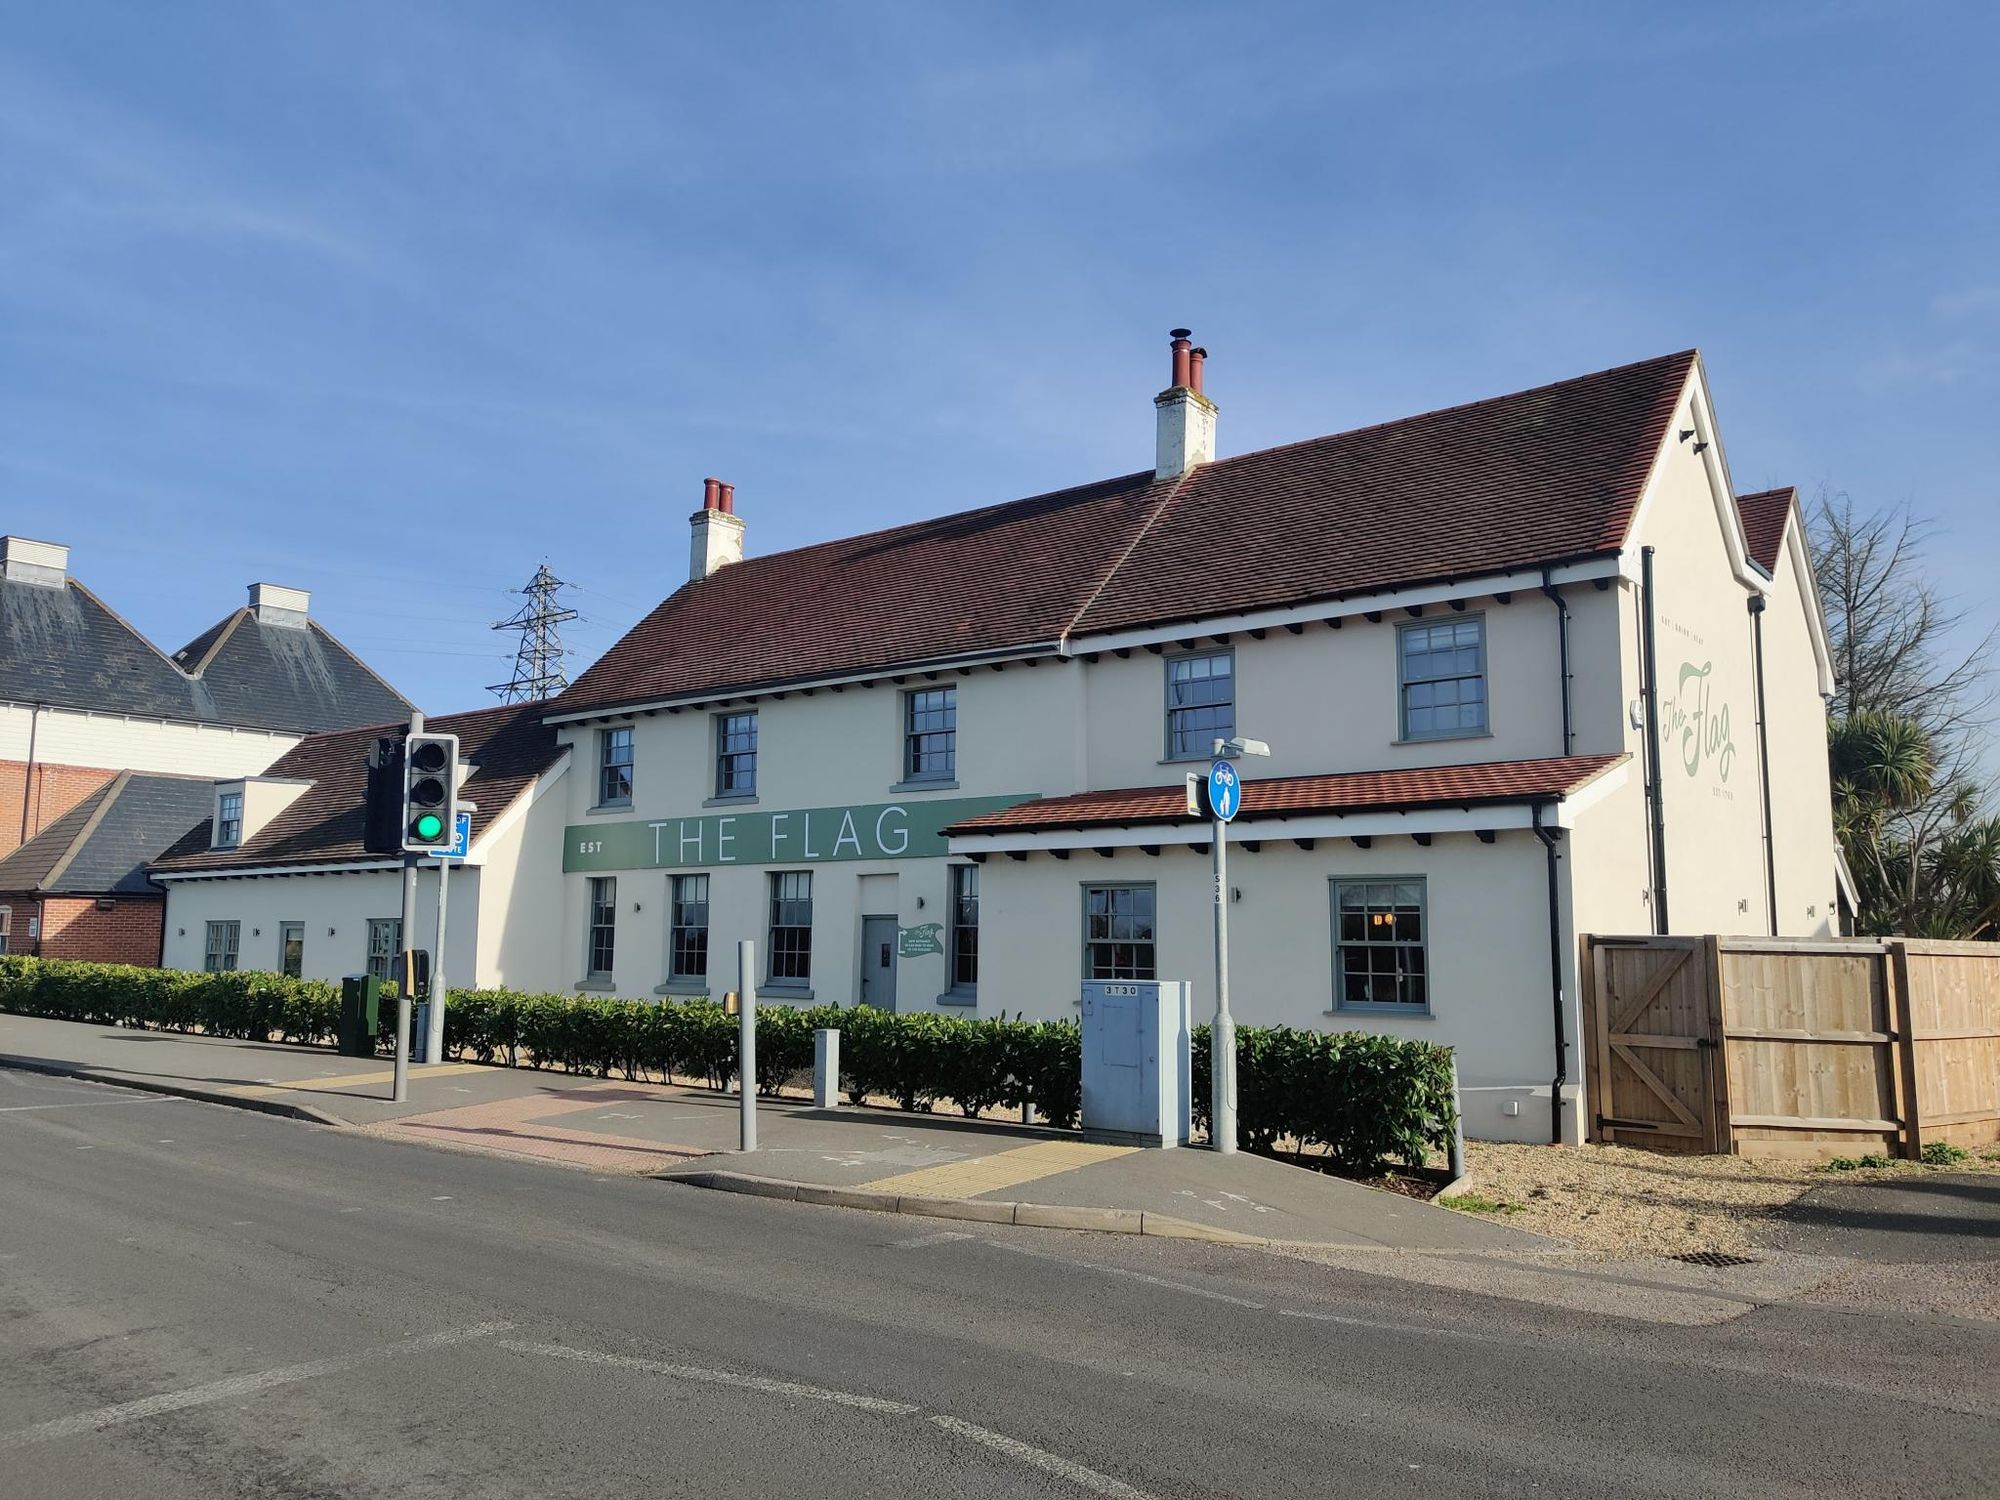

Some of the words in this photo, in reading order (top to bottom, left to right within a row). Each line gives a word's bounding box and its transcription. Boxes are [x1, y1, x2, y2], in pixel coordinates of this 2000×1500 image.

[1662, 695, 1687, 742] The
[1679, 660, 1736, 783] Flag
[580, 841, 602, 853] EST
[648, 817, 736, 864] THE
[771, 806, 909, 859] FLAG
